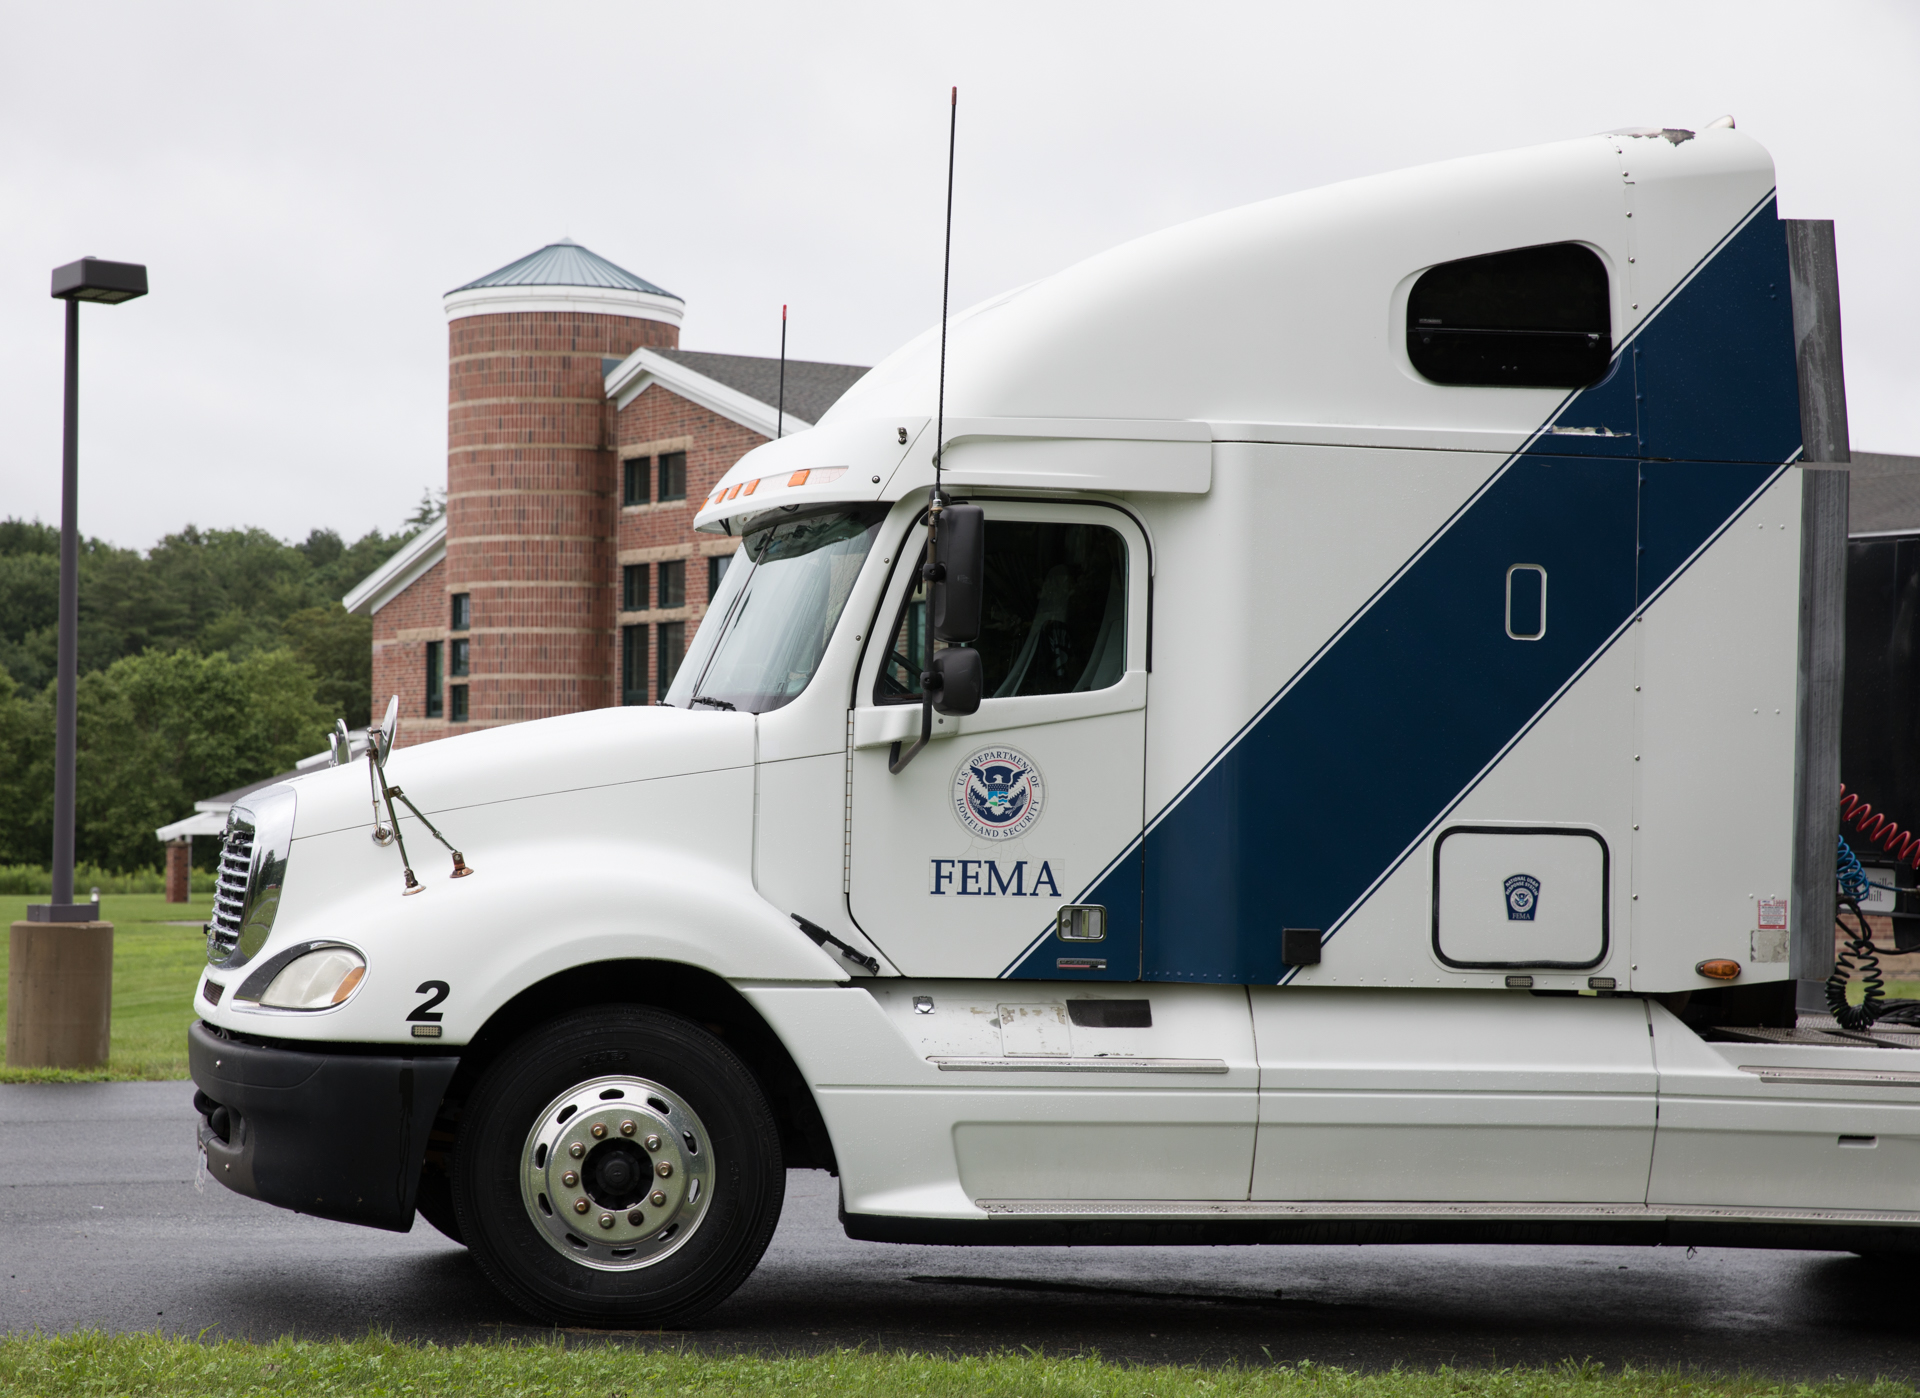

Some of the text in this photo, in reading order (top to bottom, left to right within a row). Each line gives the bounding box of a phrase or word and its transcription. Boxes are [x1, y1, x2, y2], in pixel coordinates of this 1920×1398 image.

[957, 751, 1040, 788] U.S. DEPARTMENT OF
[956, 798, 1040, 838] HOMELAND SECURITY
[930, 859, 1062, 897] FEMA
[1505, 876, 1526, 887] NATIONAL
[1512, 912, 1531, 920] FEMA
[405, 979, 451, 1022] 2
